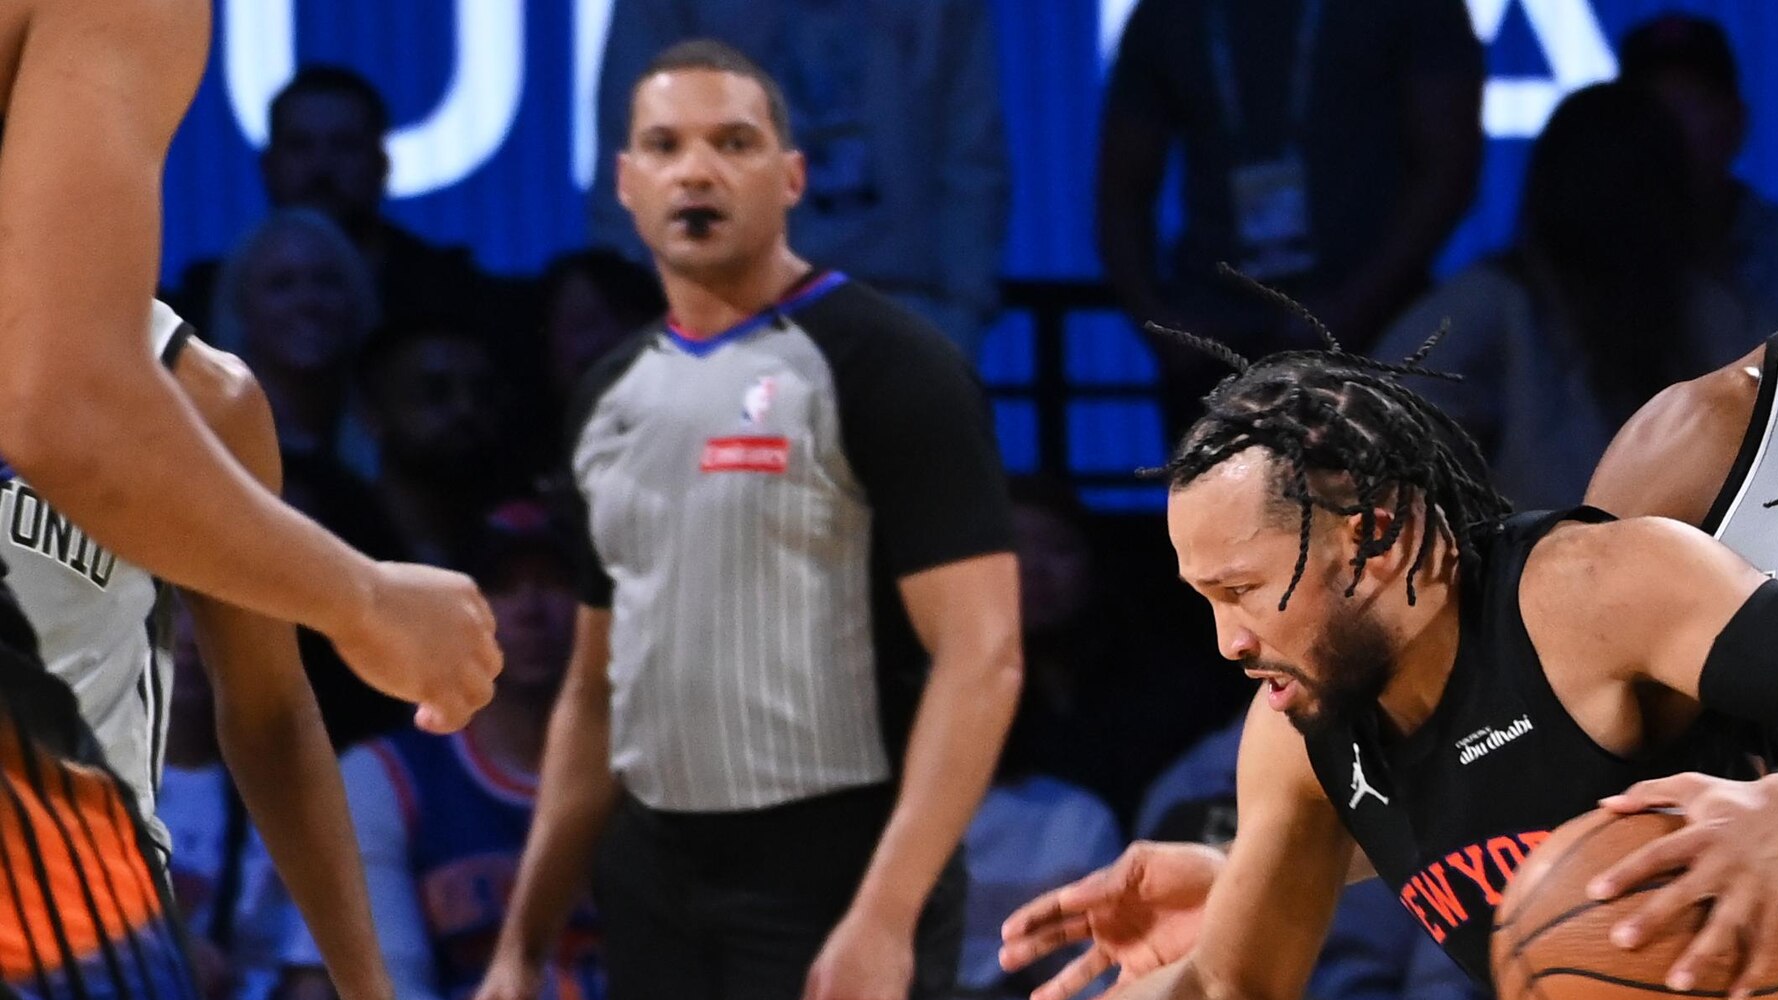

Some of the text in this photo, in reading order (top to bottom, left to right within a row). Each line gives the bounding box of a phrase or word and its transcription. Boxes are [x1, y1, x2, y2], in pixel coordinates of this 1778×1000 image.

[0, 481, 117, 588] ONIO
[1459, 744, 1489, 765] abu
[1486, 713, 1534, 750] dhabi
[1400, 861, 1470, 944] EW
